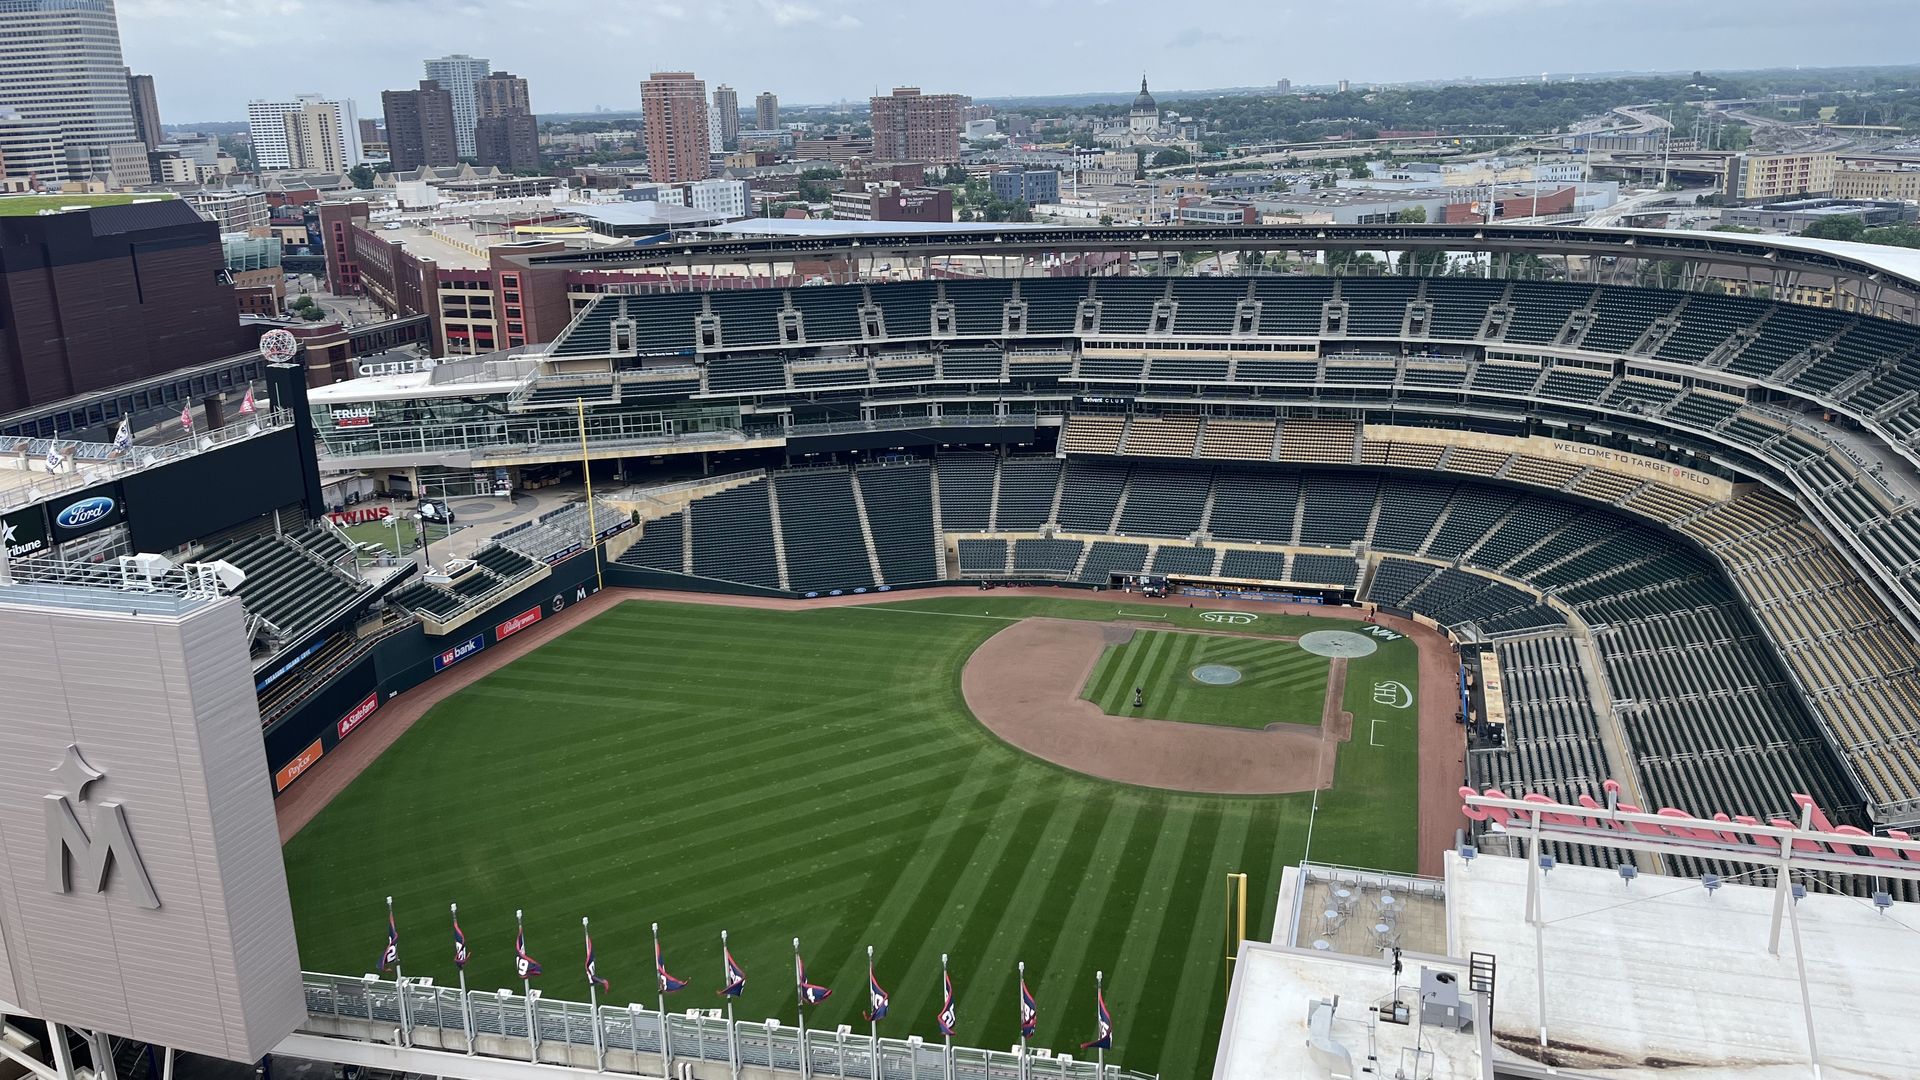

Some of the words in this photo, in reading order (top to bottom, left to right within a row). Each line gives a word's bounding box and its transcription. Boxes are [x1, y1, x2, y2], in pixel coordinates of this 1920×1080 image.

[333, 407, 372, 419] TRULY
[1554, 442, 1611, 460] WELCOME
[1614, 453, 1628, 464] TO
[1631, 457, 1672, 474] TARGET
[1681, 471, 1710, 485] FIELD
[69, 502, 103, 525] Ford
[328, 506, 391, 524] TWINS
[454, 639, 476, 658] bank
[1373, 682, 1397, 705] CHS
[288, 753, 311, 777] Paycor
